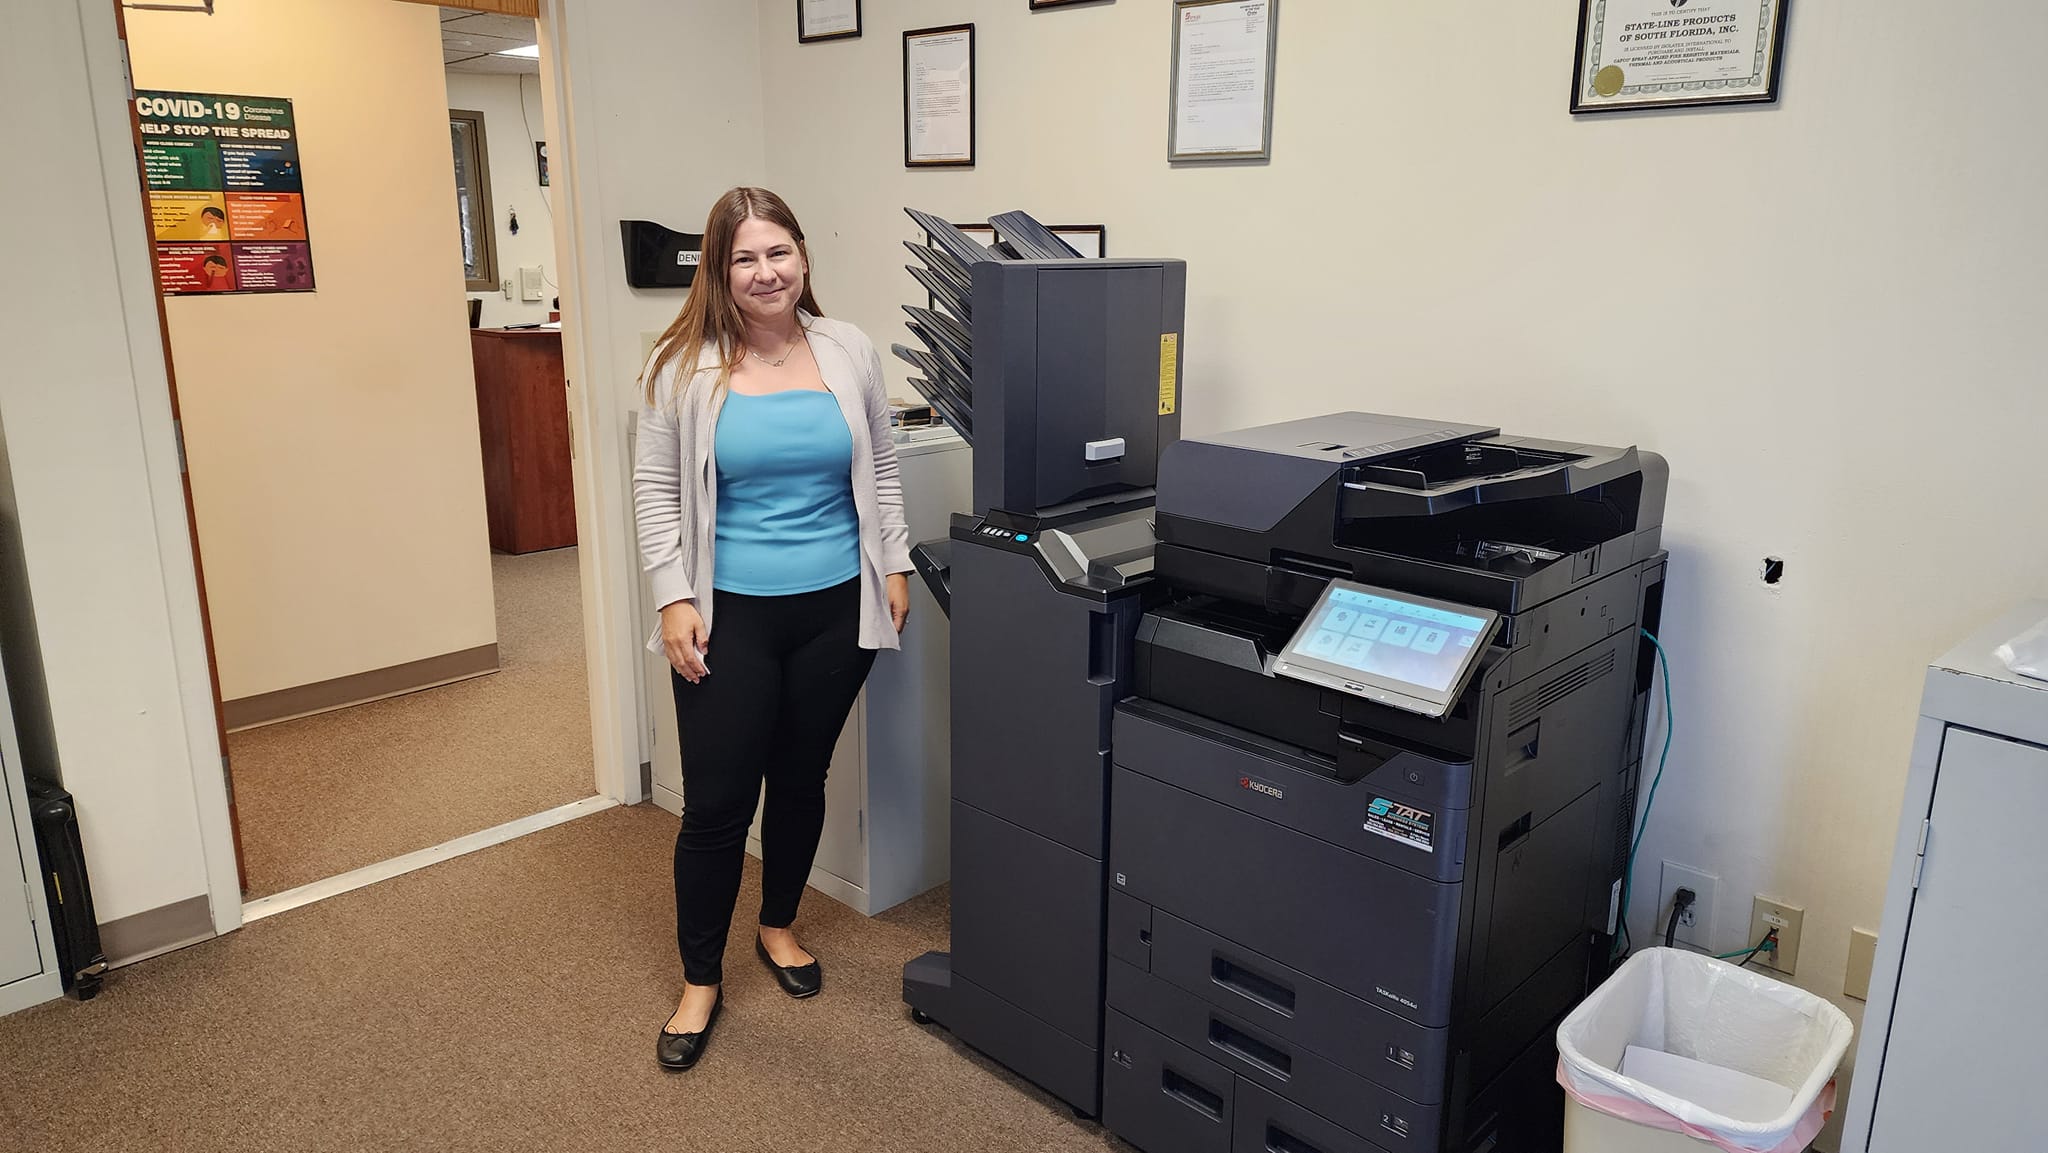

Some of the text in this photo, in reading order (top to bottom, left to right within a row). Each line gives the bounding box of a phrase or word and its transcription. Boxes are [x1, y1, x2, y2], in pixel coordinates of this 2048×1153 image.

[1624, 14, 1736, 32] STATE-LINE PRODUCTS
[1619, 25, 1739, 42] OF SOUTH FLORIDA, INC.
[136, 96, 241, 121] COVID-19
[173, 124, 210, 136] STOP
[212, 126, 240, 137] THE
[240, 128, 291, 140] SPREAD
[1249, 780, 1283, 799] KYOCERA
[1383, 1114, 1389, 1123] 2
